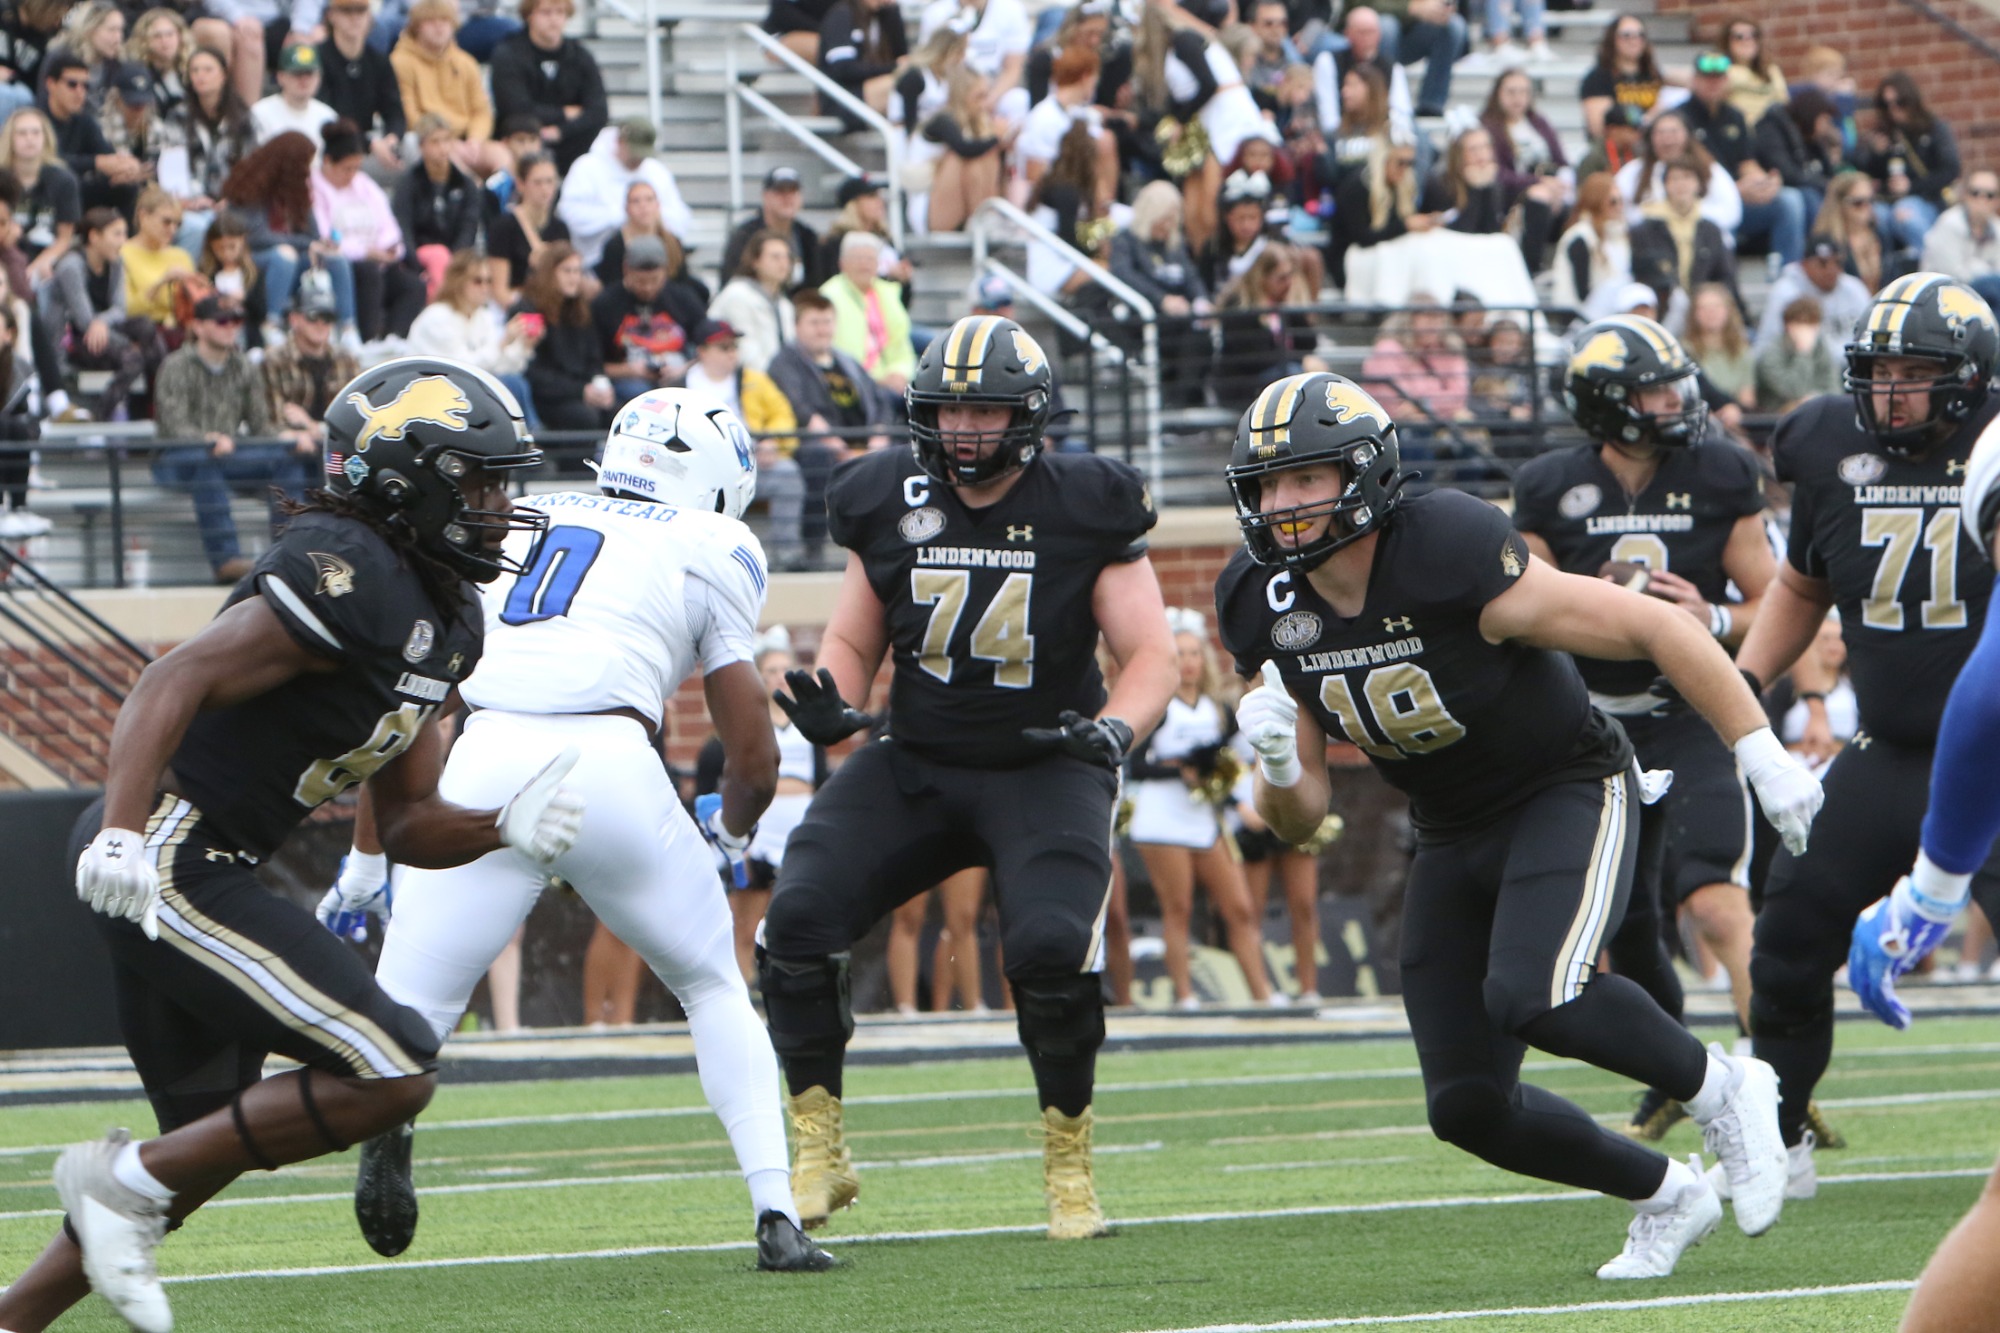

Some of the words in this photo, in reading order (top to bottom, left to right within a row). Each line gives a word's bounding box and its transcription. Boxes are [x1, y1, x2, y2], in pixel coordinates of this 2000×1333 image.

[602, 470, 656, 493] PANTHERS
[903, 475, 930, 507] C
[524, 494, 678, 523] ARMSTEAD
[1586, 514, 1693, 535] LINDENWOOD
[498, 525, 605, 627] 0
[916, 546, 1036, 569] LINDENWOOD
[1861, 508, 1967, 631] 71
[1266, 570, 1295, 612] C
[911, 567, 1035, 689] 74
[1297, 636, 1424, 673] LINDENWOOD
[1319, 661, 1467, 760] 18
